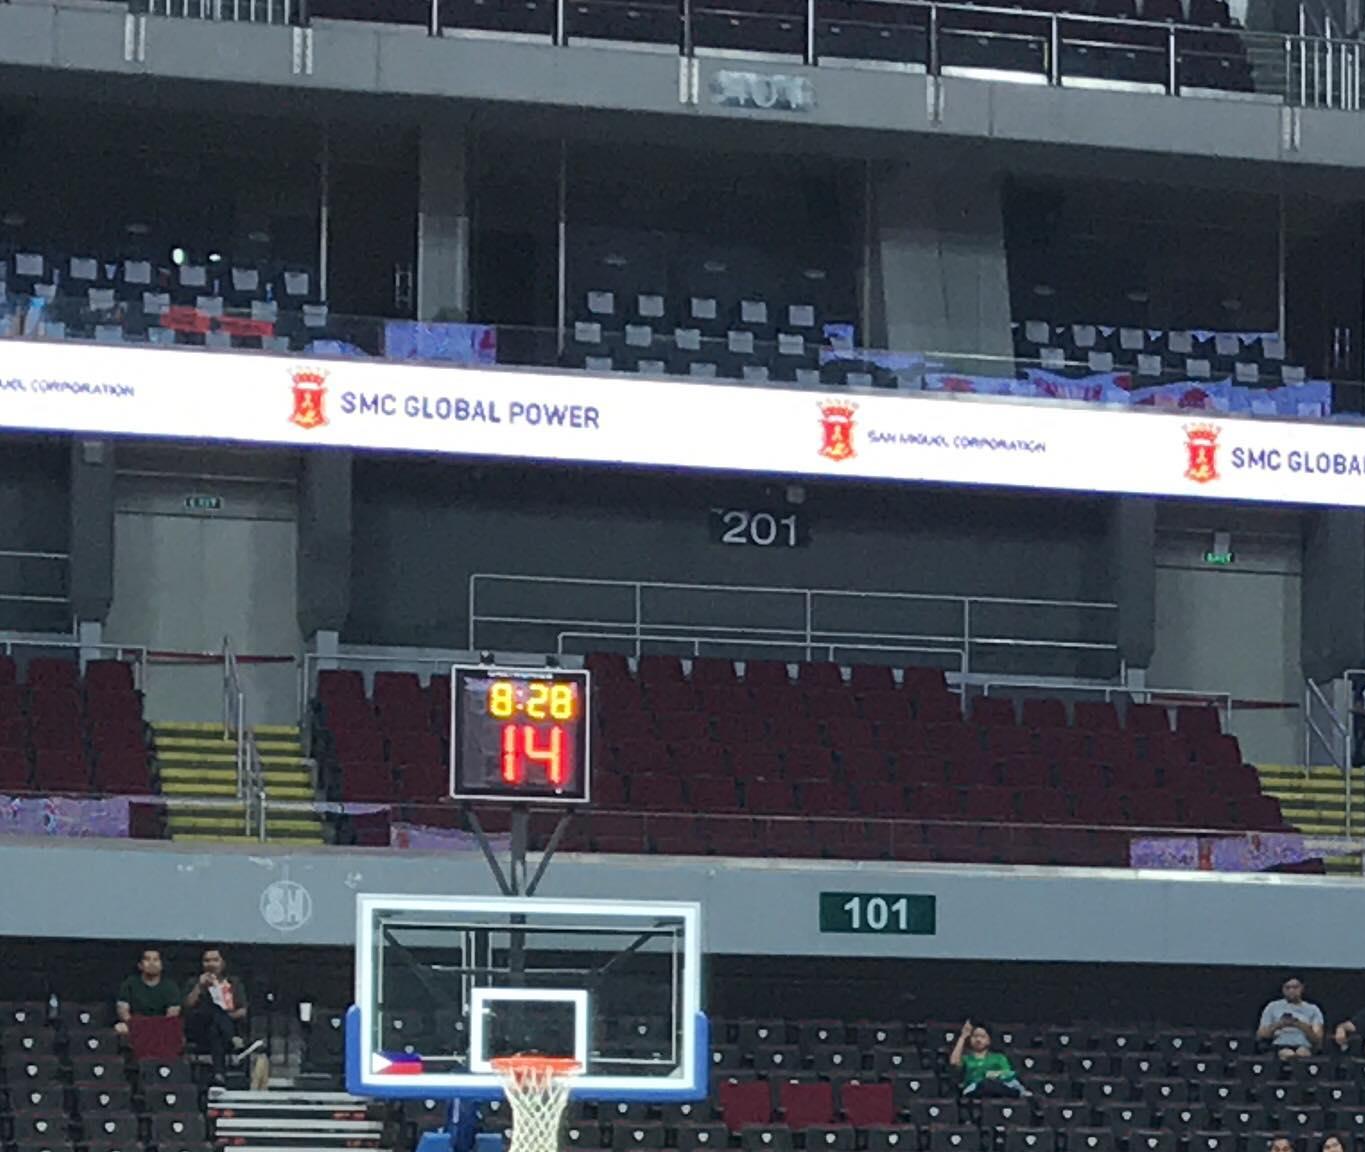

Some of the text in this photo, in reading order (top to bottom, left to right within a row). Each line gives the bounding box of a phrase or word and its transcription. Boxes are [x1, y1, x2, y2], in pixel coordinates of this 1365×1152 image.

[340, 391, 600, 429] SMC GLOBAL POWER
[1231, 446, 1281, 471] SMC
[723, 511, 796, 546] 201
[489, 680, 572, 720] 8:28
[503, 724, 562, 783] 14
[843, 896, 908, 930] 101
